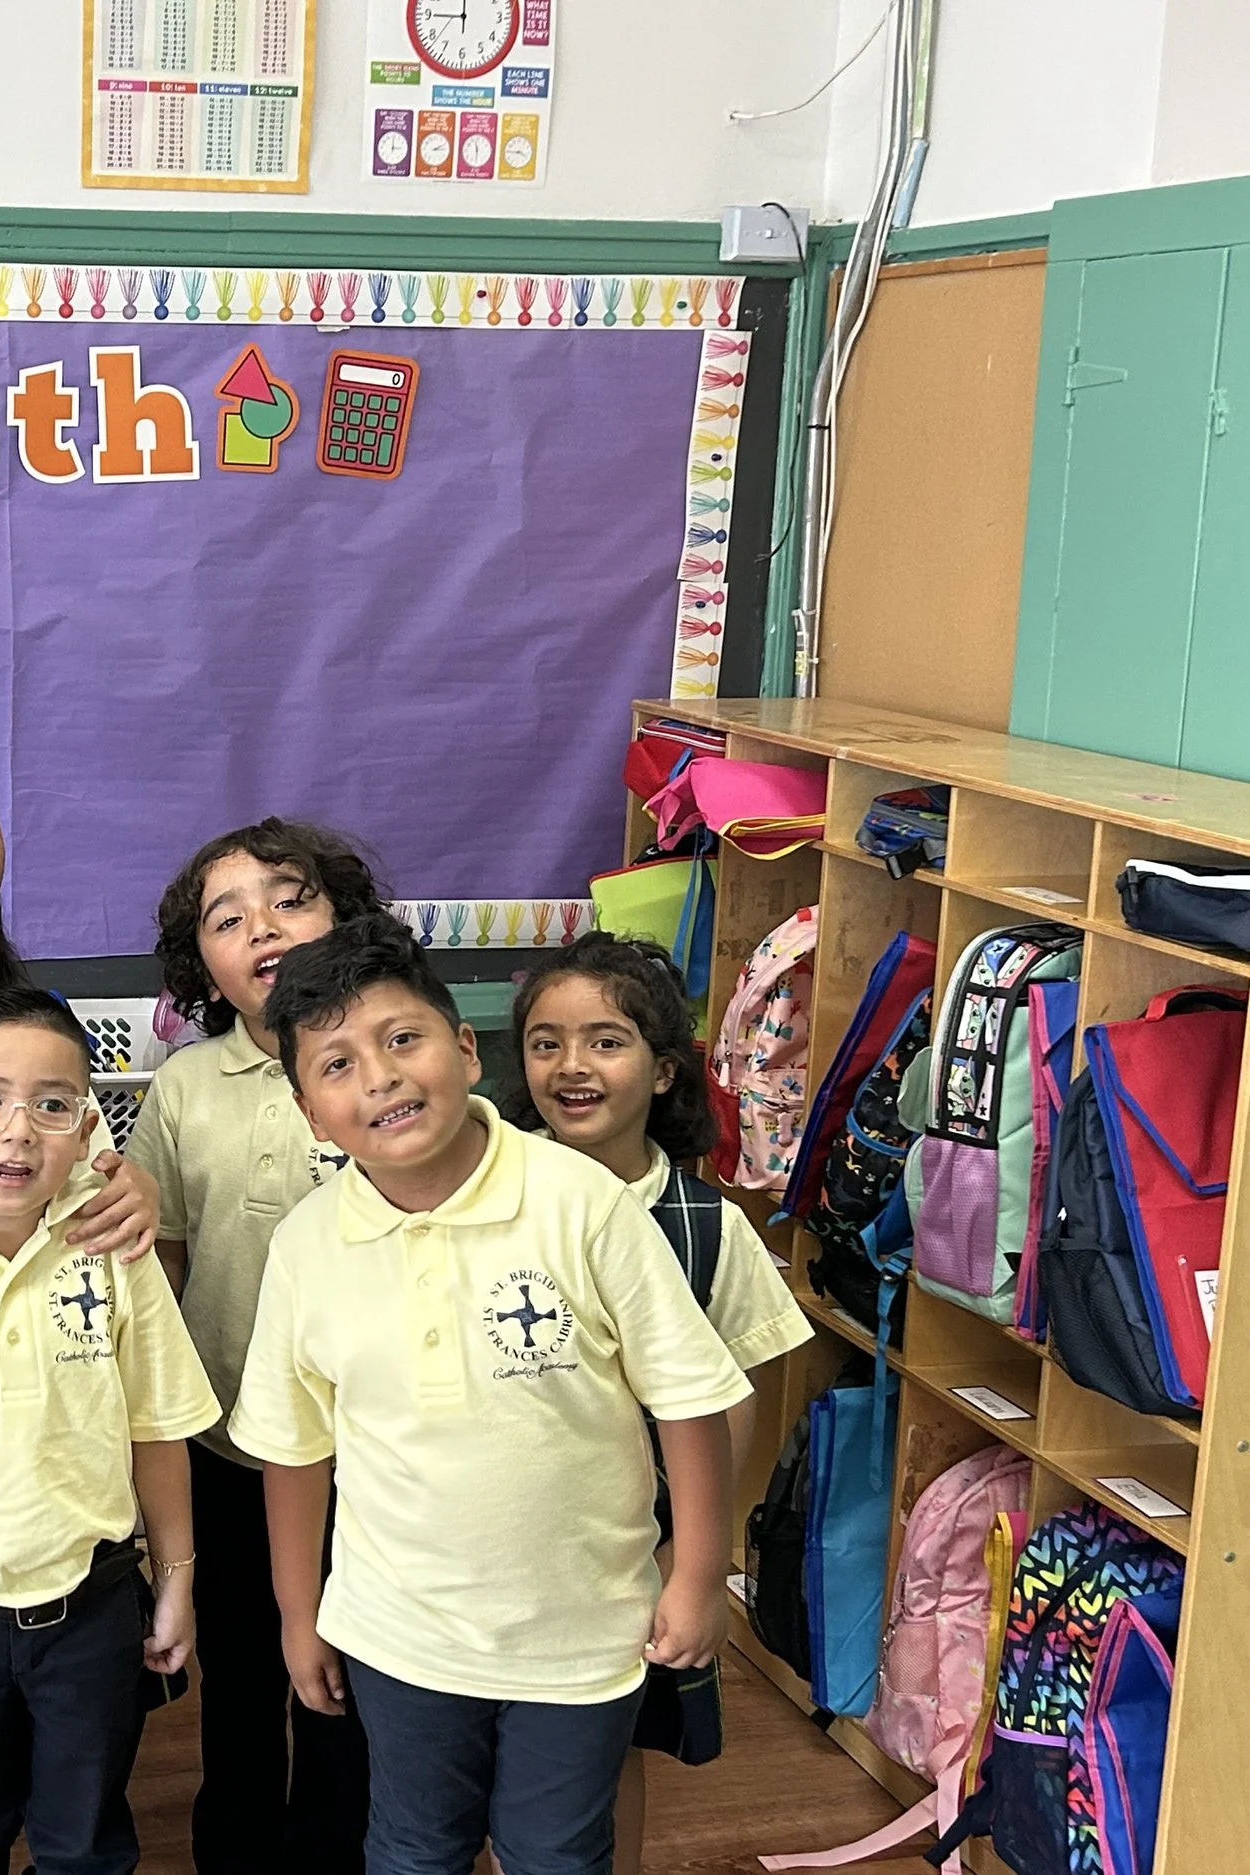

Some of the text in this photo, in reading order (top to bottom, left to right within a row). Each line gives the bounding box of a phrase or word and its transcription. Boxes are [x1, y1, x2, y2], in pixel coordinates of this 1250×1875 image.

[525, 0, 549, 10] WHAT
[425, 8, 503, 24] 9 3
[526, 10, 548, 20] TIME
[526, 20, 547, 29] IS IT
[429, 28, 496, 42] 8 4
[524, 29, 548, 39] NOW?
[442, 40, 484, 53] 7 5
[458, 47, 466, 59] 6
[118, 83, 133, 91] nine
[218, 86, 242, 94] eleven
[268, 88, 293, 96] twelve
[308, 1146, 319, 1164] ST.
[54, 1265, 72, 1282] ST.
[490, 1269, 556, 1298] ST. BRIGID
[48, 1290, 58, 1311] ST.
[52, 1312, 104, 1344] FRANCES
[482, 1299, 573, 1362] ST. FRANCES CABRINI
[492, 1361, 579, 1381] Catholic Academy
